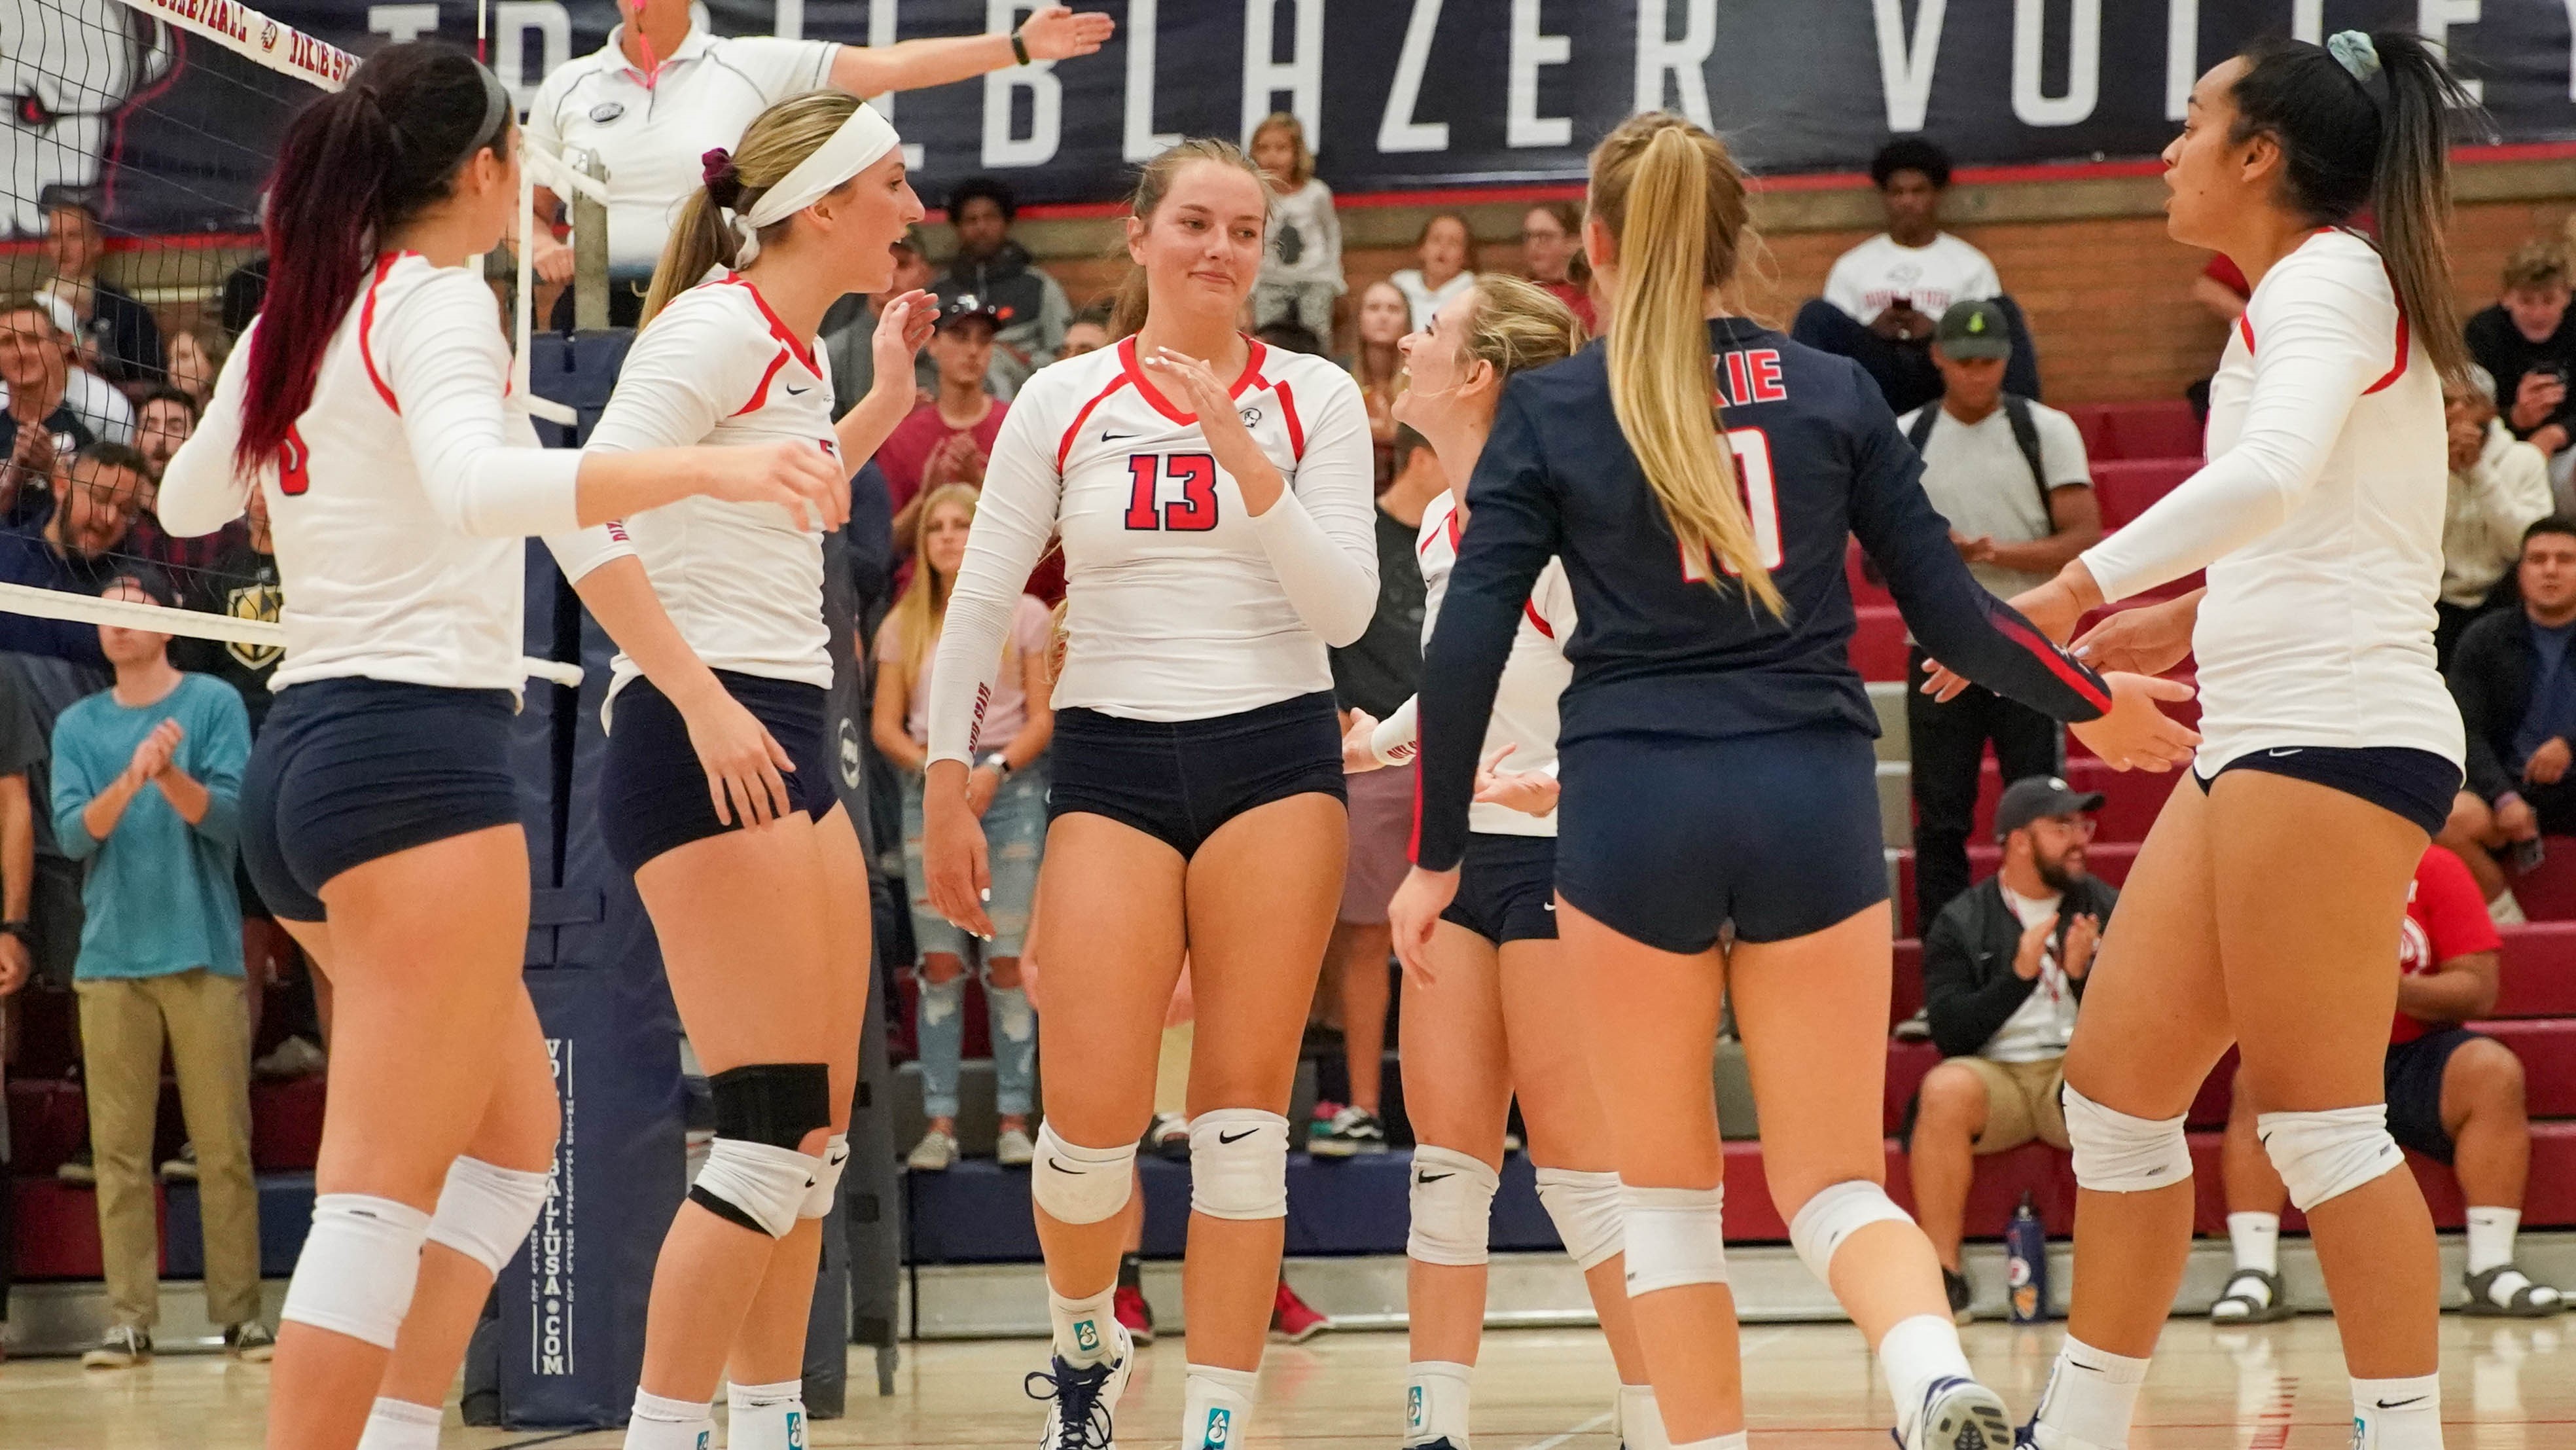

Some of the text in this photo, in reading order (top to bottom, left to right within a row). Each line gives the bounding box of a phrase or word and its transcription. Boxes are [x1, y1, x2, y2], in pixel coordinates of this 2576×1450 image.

[151, 0, 247, 43] EYBALL
[368, 0, 1716, 172] RBLAZER
[1124, 453, 1219, 532] 13
[1678, 426, 1785, 584] 0
[974, 681, 991, 724] STATE
